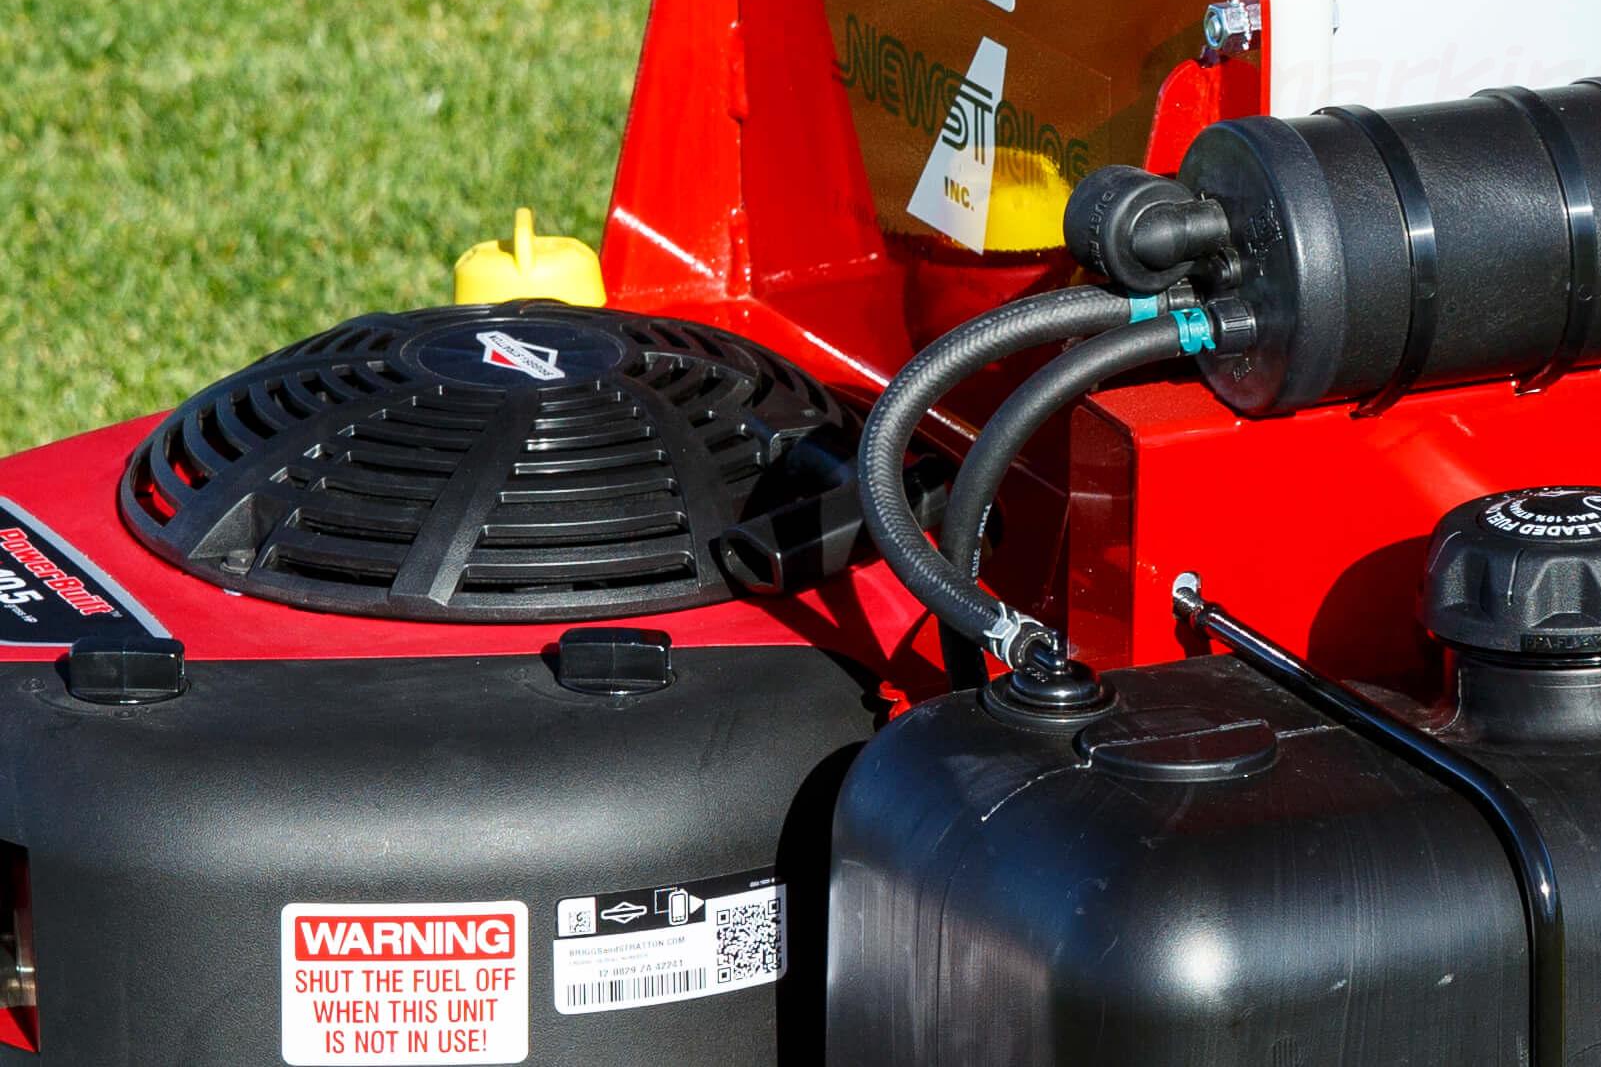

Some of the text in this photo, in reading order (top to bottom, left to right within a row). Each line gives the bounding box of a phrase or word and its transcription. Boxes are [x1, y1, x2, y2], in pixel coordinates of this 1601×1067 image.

[944, 176, 975, 212] INC.
[0, 527, 113, 616] PowerBuilt
[300, 920, 510, 956] WARNING
[295, 967, 516, 993] SHUT THE FUEL OFF
[313, 998, 499, 1024] WHEN THIS UNIT
[325, 1028, 488, 1054] IS NOT IN USE!
